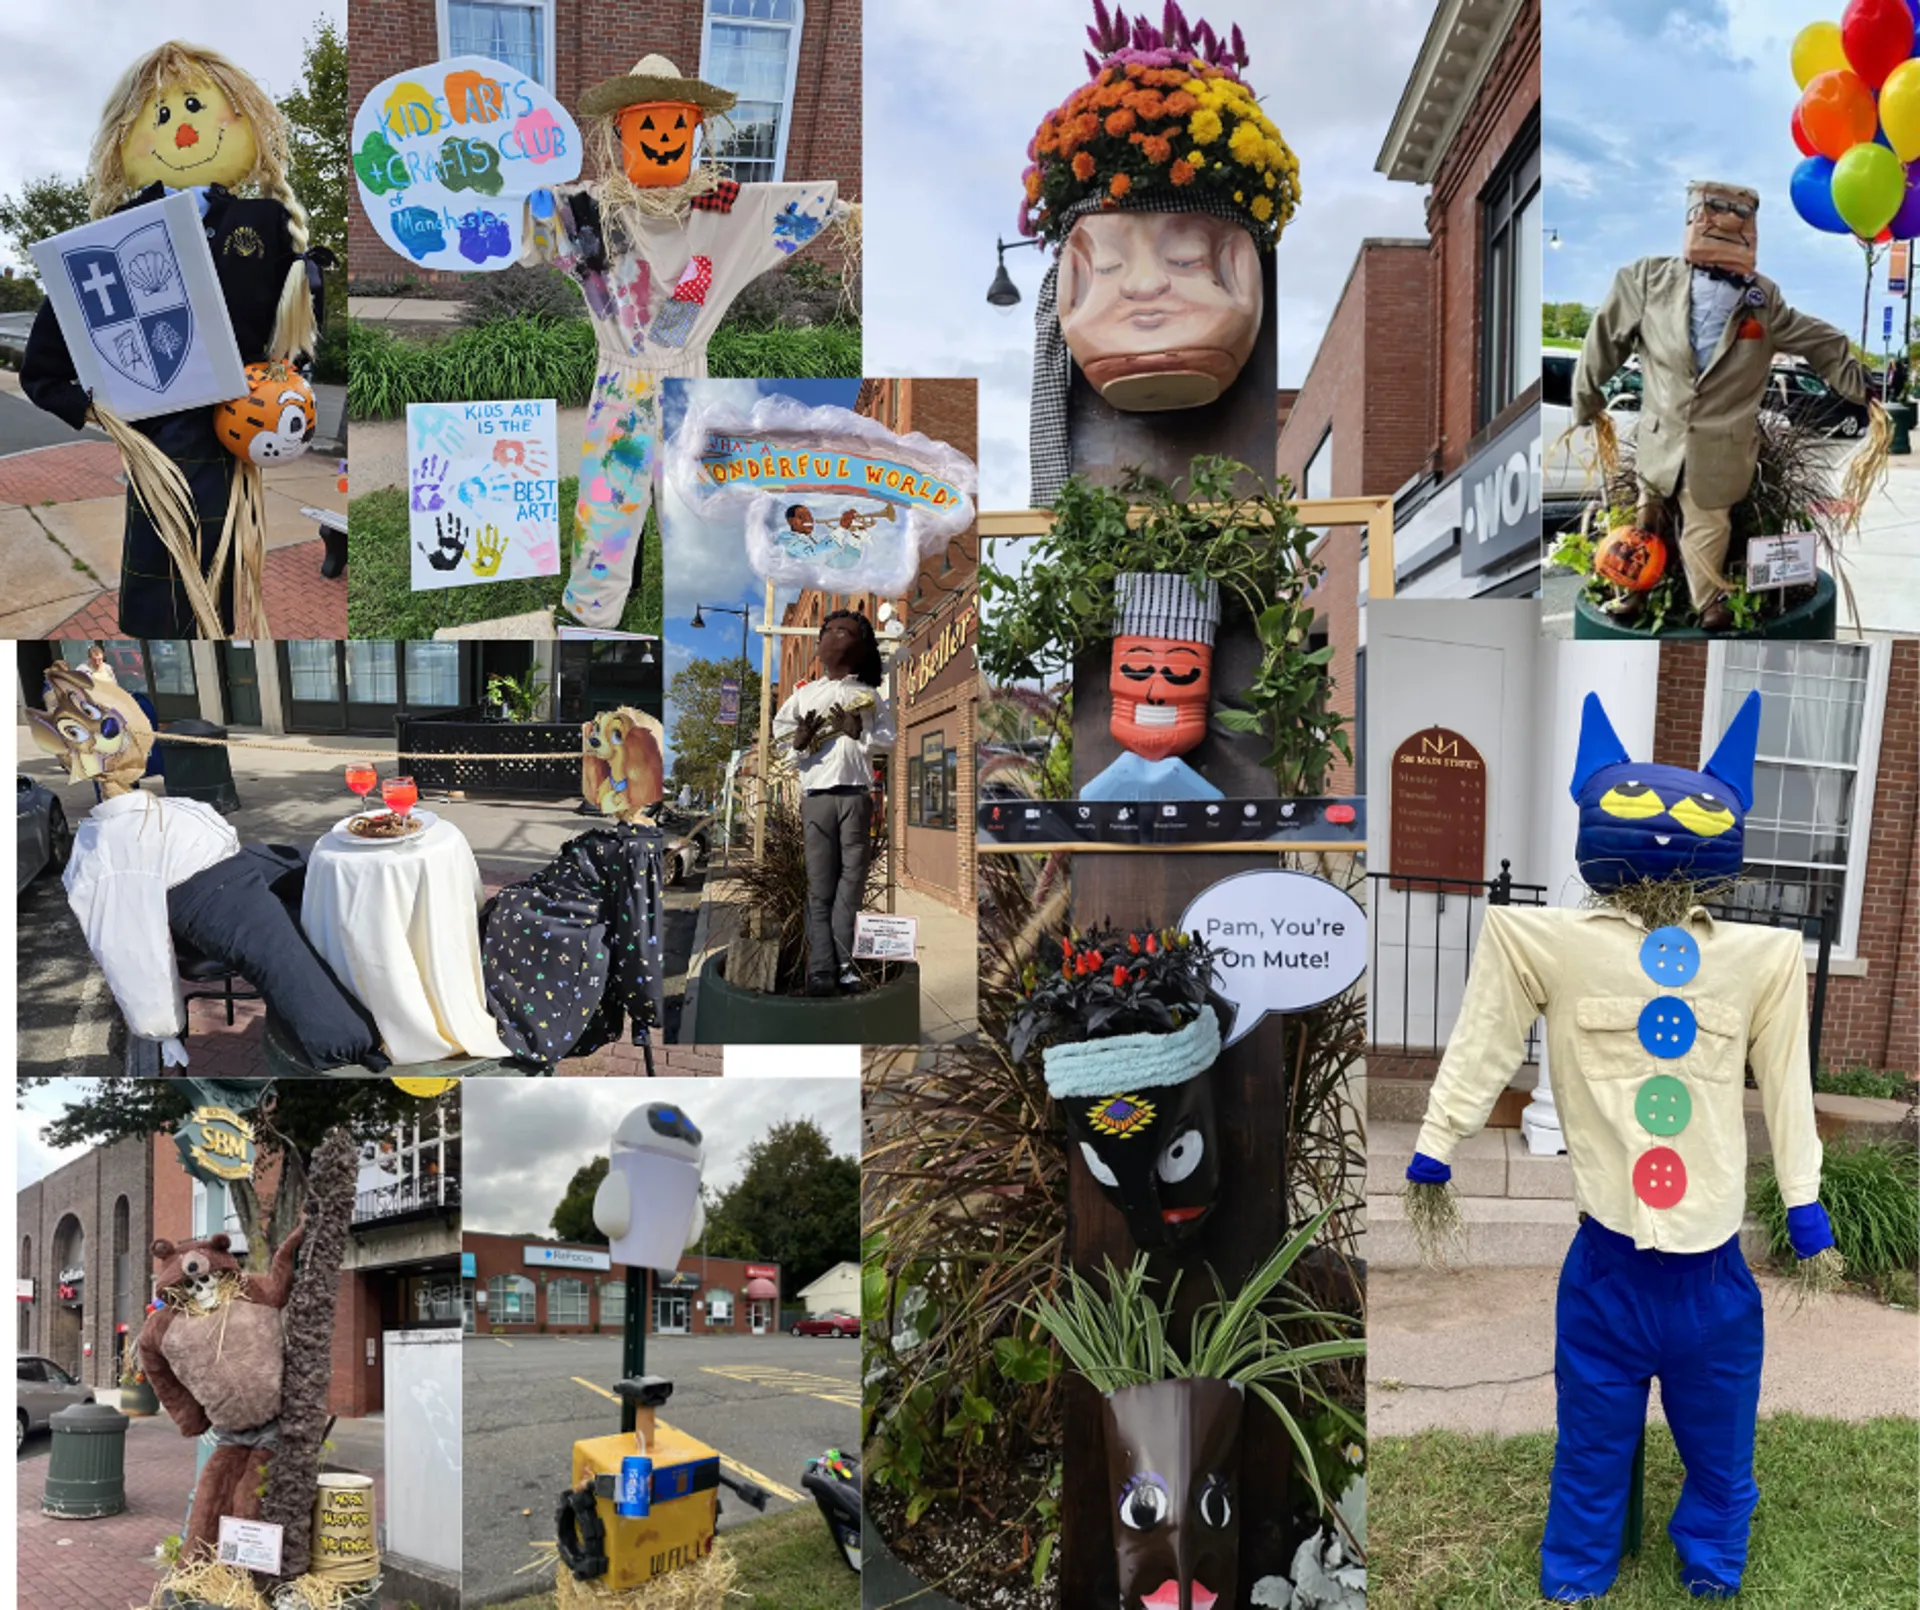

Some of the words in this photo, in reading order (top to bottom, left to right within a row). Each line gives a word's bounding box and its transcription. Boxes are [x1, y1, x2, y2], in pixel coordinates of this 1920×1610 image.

[375, 97, 452, 144] KIDS
[466, 80, 533, 123] ARTS
[499, 126, 567, 161] CLUB
[389, 192, 403, 207] of
[398, 206, 508, 235] Manchester
[464, 405, 503, 420] KIDS
[511, 403, 542, 417] ART
[478, 421, 494, 434] IS
[499, 419, 532, 432] THE
[760, 443, 771, 456] A
[513, 480, 557, 502] BEST
[865, 464, 959, 510] WORLD!
[517, 502, 557, 522] ART!
[1416, 756, 1442, 766] MAIN
[1444, 757, 1480, 770] STREET
[1206, 918, 1265, 939] Pam,
[1271, 917, 1345, 936] You're
[1222, 950, 1256, 968] On
[1264, 951, 1329, 969] Mute!
[201, 1126, 247, 1160] SBM
